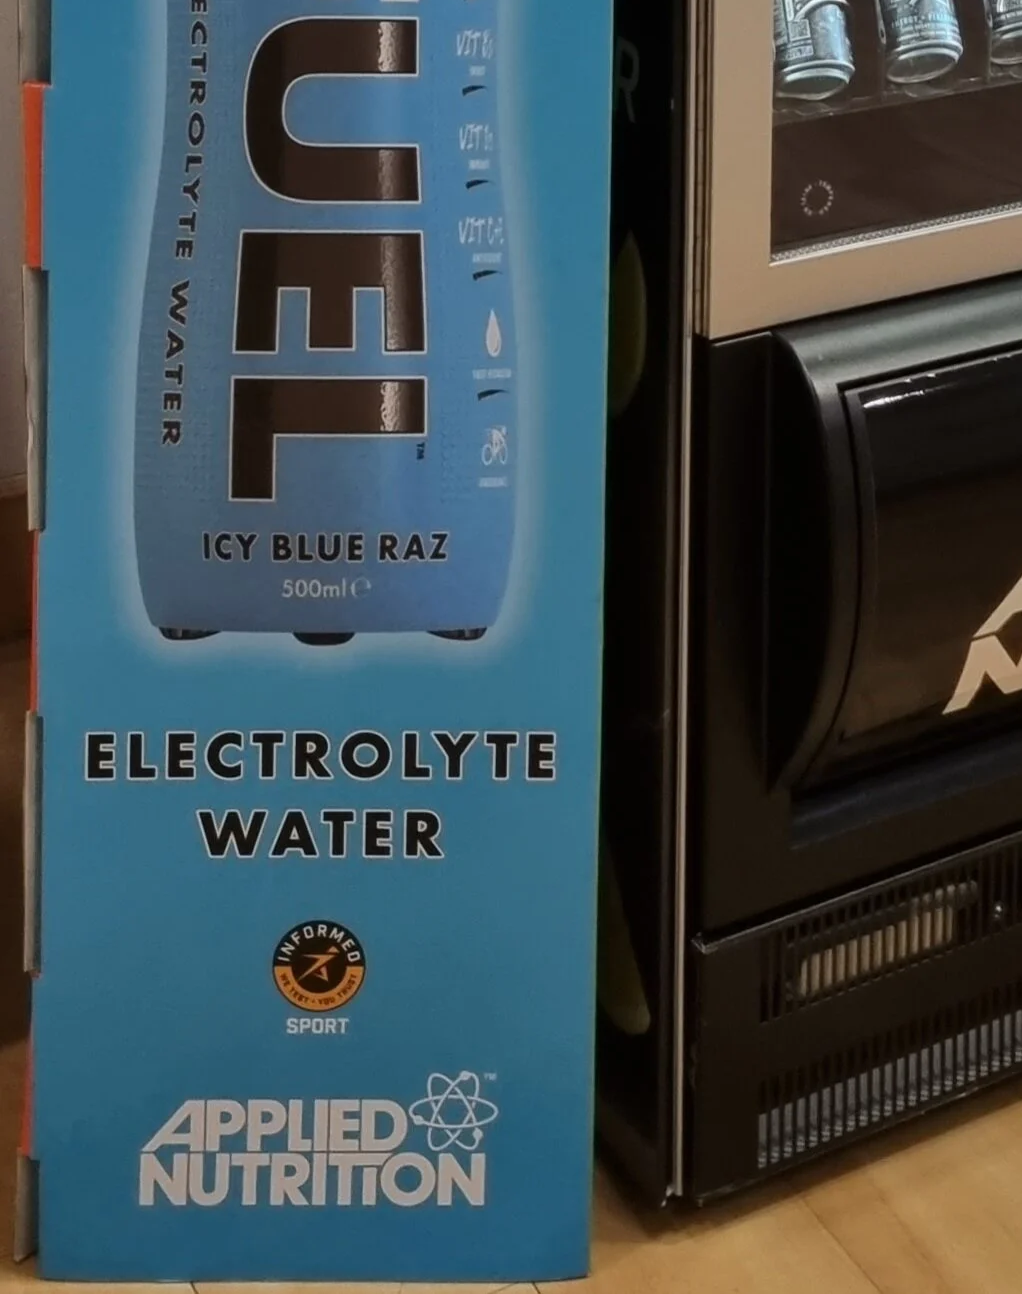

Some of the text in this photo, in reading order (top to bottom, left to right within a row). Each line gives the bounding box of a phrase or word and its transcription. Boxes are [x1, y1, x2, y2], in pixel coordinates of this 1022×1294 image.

[159, 279, 191, 448] WATER
[202, 532, 450, 563] ICY BLUE RAZ
[281, 577, 347, 600] 500ml
[84, 730, 557, 781] ELECTROLYTE
[197, 809, 445, 860] WATER
[277, 922, 362, 964] INFORMED
[278, 972, 359, 1007] WE TEST YOU TRUST
[286, 1017, 349, 1036] SPORT
[141, 1098, 409, 1153] APPLIED
[137, 1152, 487, 1207] NUTRITION
